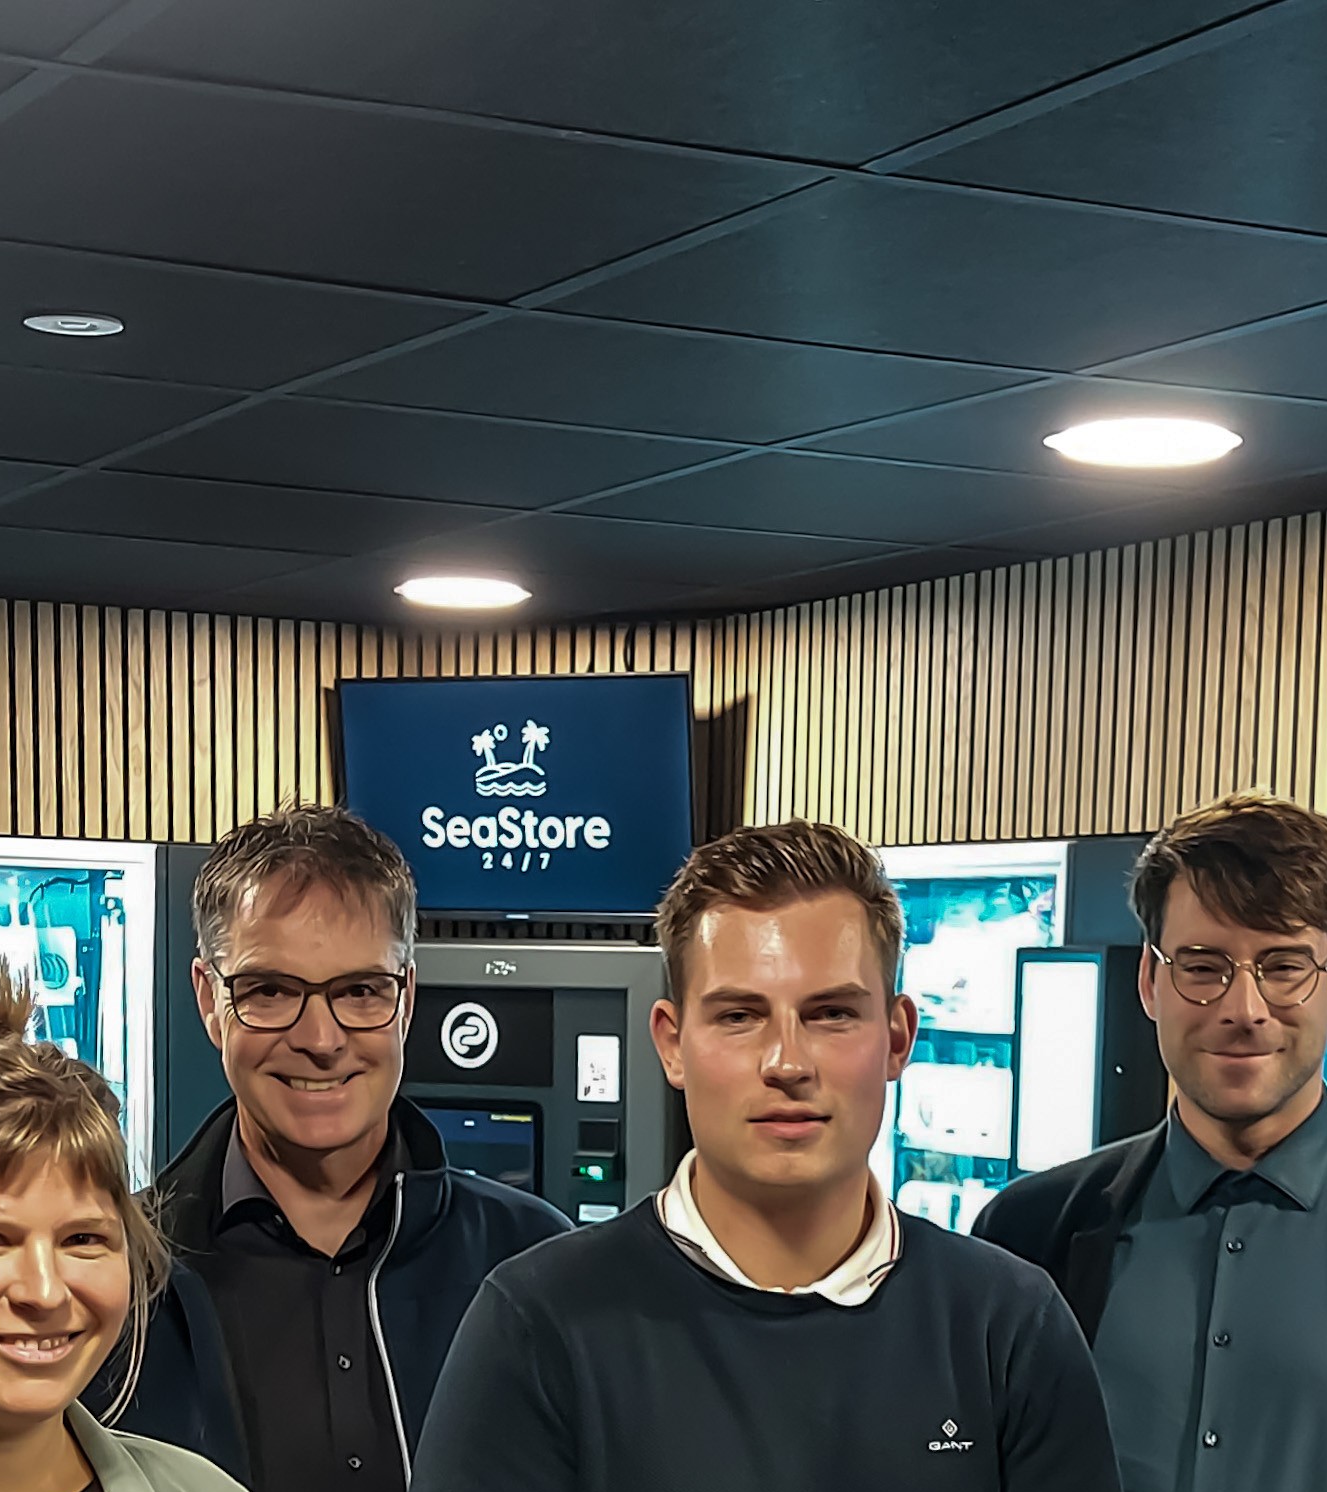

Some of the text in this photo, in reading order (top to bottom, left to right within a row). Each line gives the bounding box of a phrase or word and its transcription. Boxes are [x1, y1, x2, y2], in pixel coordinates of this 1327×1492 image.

[422, 806, 611, 849] SeaStore
[482, 852, 551, 872] 24/7
[928, 1440, 974, 1452] GANT
